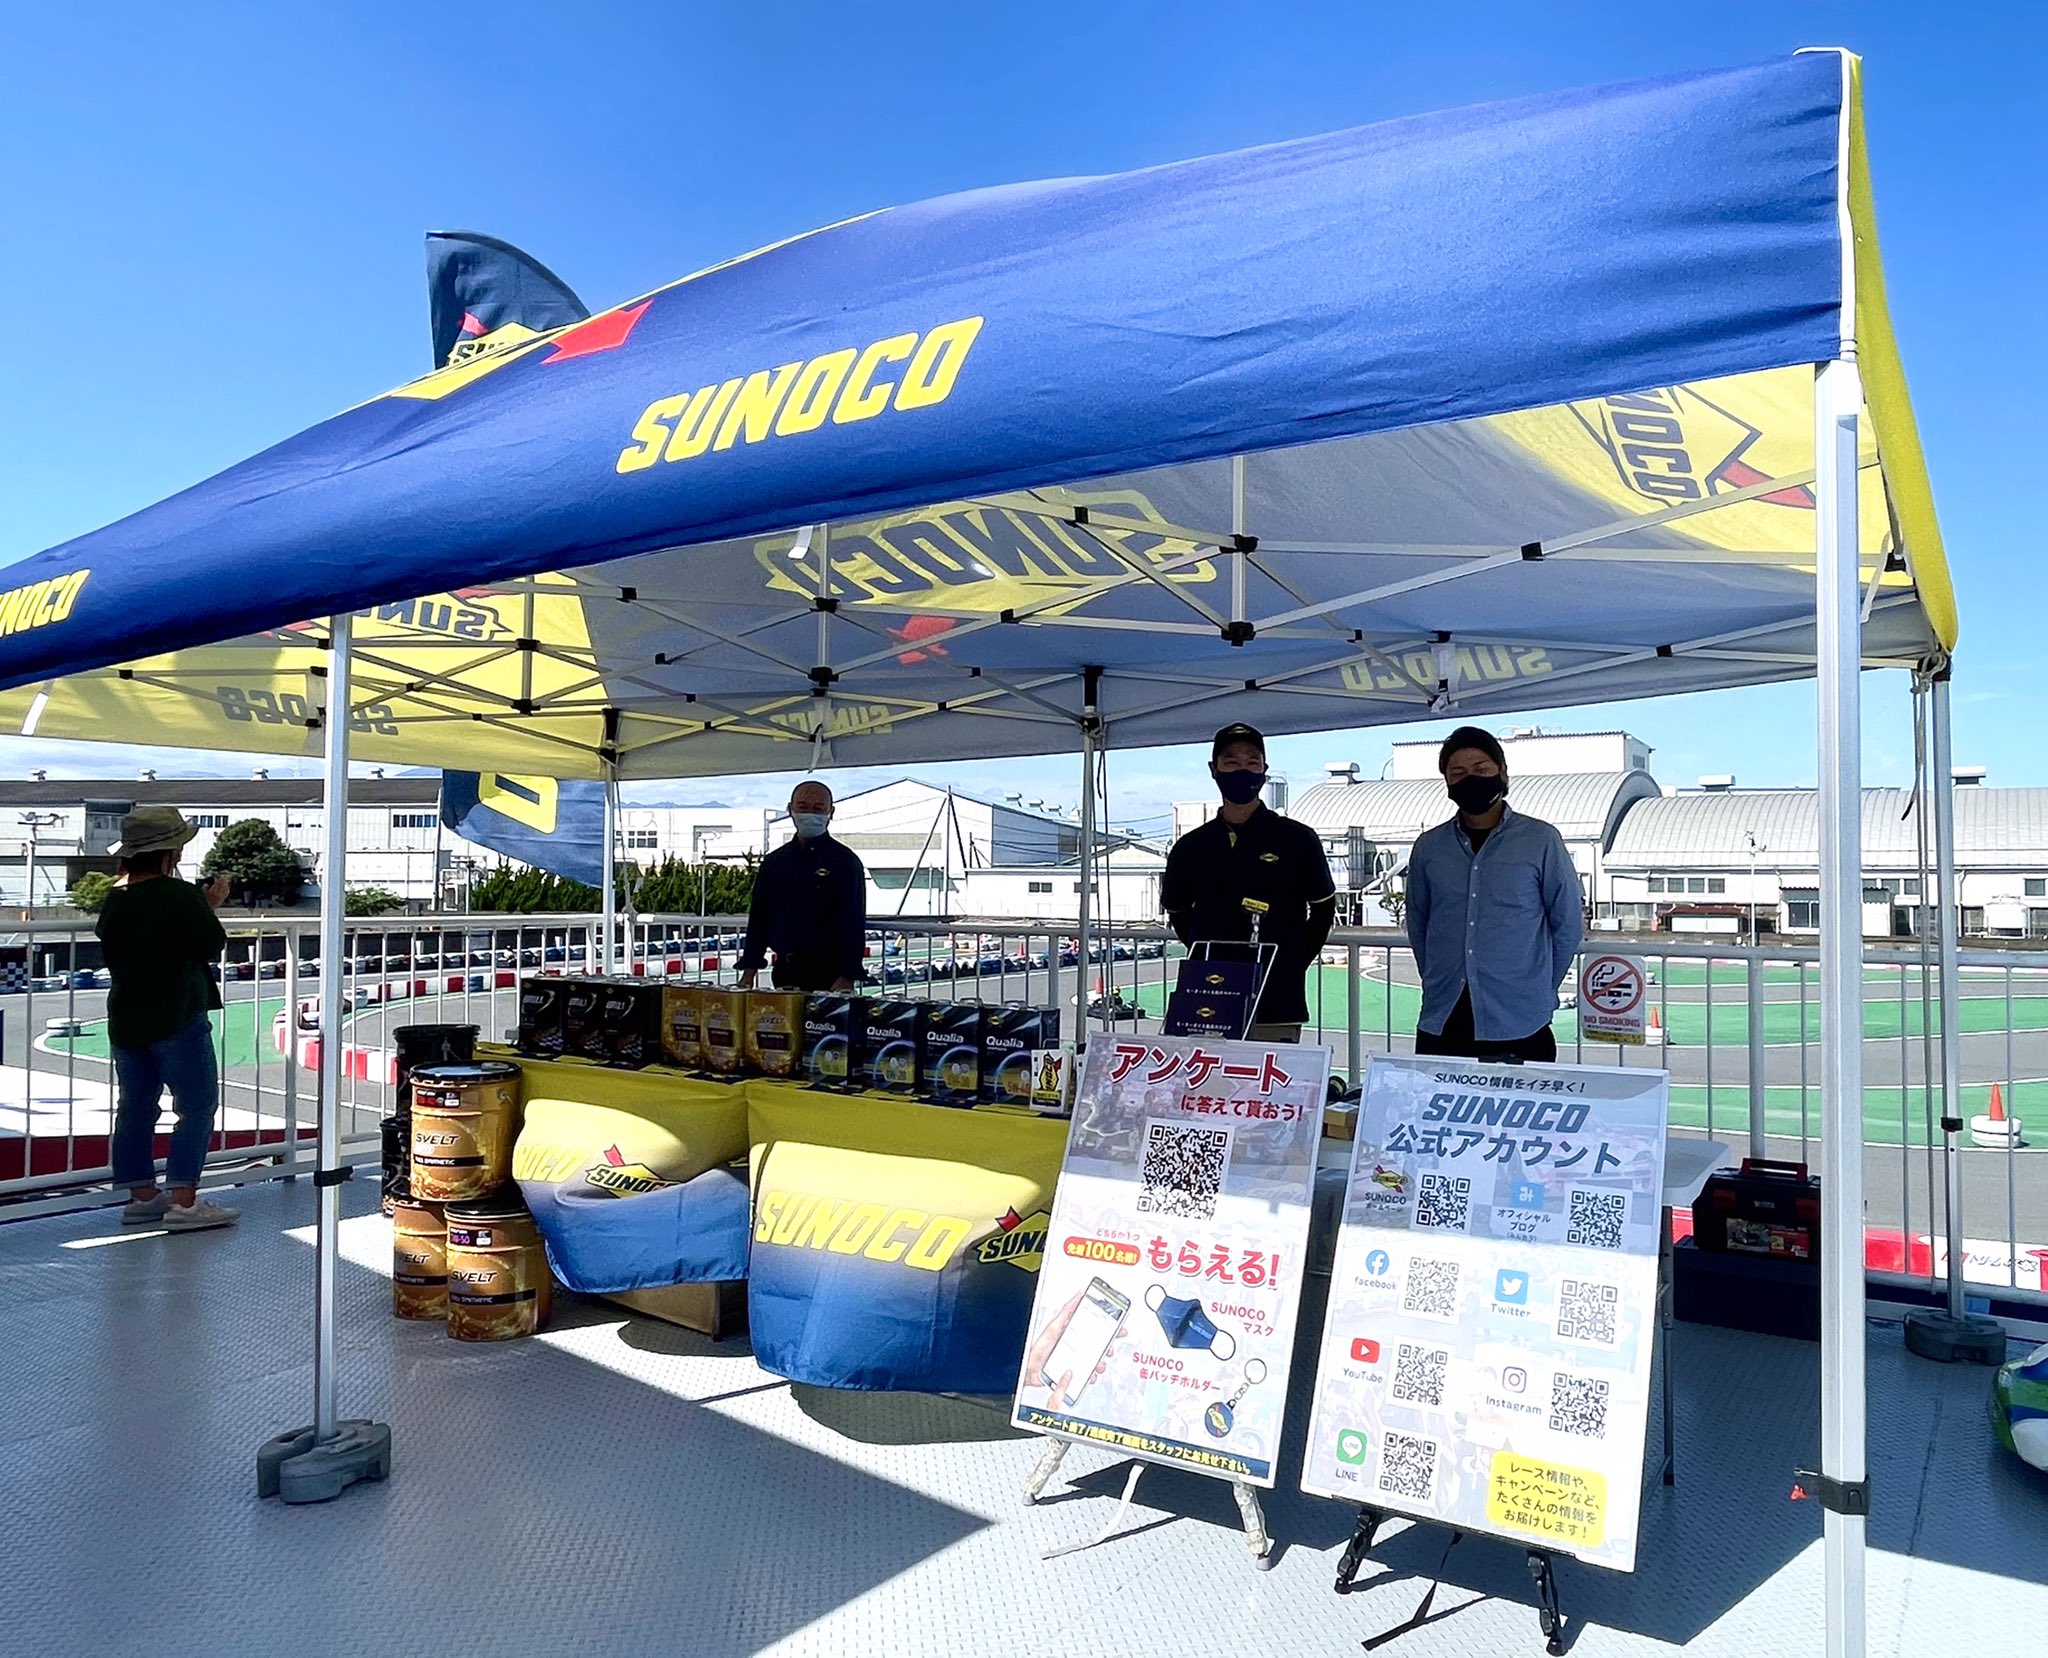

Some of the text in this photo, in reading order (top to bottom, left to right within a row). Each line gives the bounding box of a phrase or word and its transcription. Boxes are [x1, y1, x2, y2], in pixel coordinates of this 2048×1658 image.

[615, 316, 985, 474] SUNOCO
[0, 569, 91, 638] NOCO
[805, 1020, 836, 1032] Qualia
[1583, 1014, 1640, 1027] NO SMOKING
[866, 1026, 902, 1038] Qualia
[927, 1031, 964, 1043] Qualia
[986, 1035, 1024, 1048] Qualia
[1110, 1043, 1291, 1095] アンケート
[1180, 1094, 1304, 1122] に答えて貰おう！
[1422, 1093, 1591, 1133] SUNOCO
[415, 1133, 459, 1146] SVELT
[1386, 1122, 1621, 1173] 公式アカウント
[1365, 1192, 1407, 1205] SUNOCO
[1497, 1209, 1551, 1223] オフィシャル
[756, 1191, 973, 1272] SUNOCO
[1510, 1221, 1537, 1233] ブログ
[1148, 1235, 1281, 1289] もらえる！
[452, 1271, 498, 1283] SVELT
[1354, 1276, 1397, 1291] facebook
[1211, 1302, 1266, 1321] SUNOCO
[1490, 1303, 1532, 1318] Twitter
[1242, 1321, 1274, 1337] マスク
[1132, 1351, 1184, 1371] SUNOCO
[1342, 1367, 1384, 1383] YouTube
[1485, 1395, 1542, 1416] Instagram
[1335, 1468, 1359, 1482] LINE
[1511, 1462, 1588, 1491] レース情報や、
[1496, 1475, 1600, 1510] キャンペーンなど、
[1497, 1491, 1597, 1524] たくさんの情報を
[1504, 1509, 1588, 1539] お届けします！
